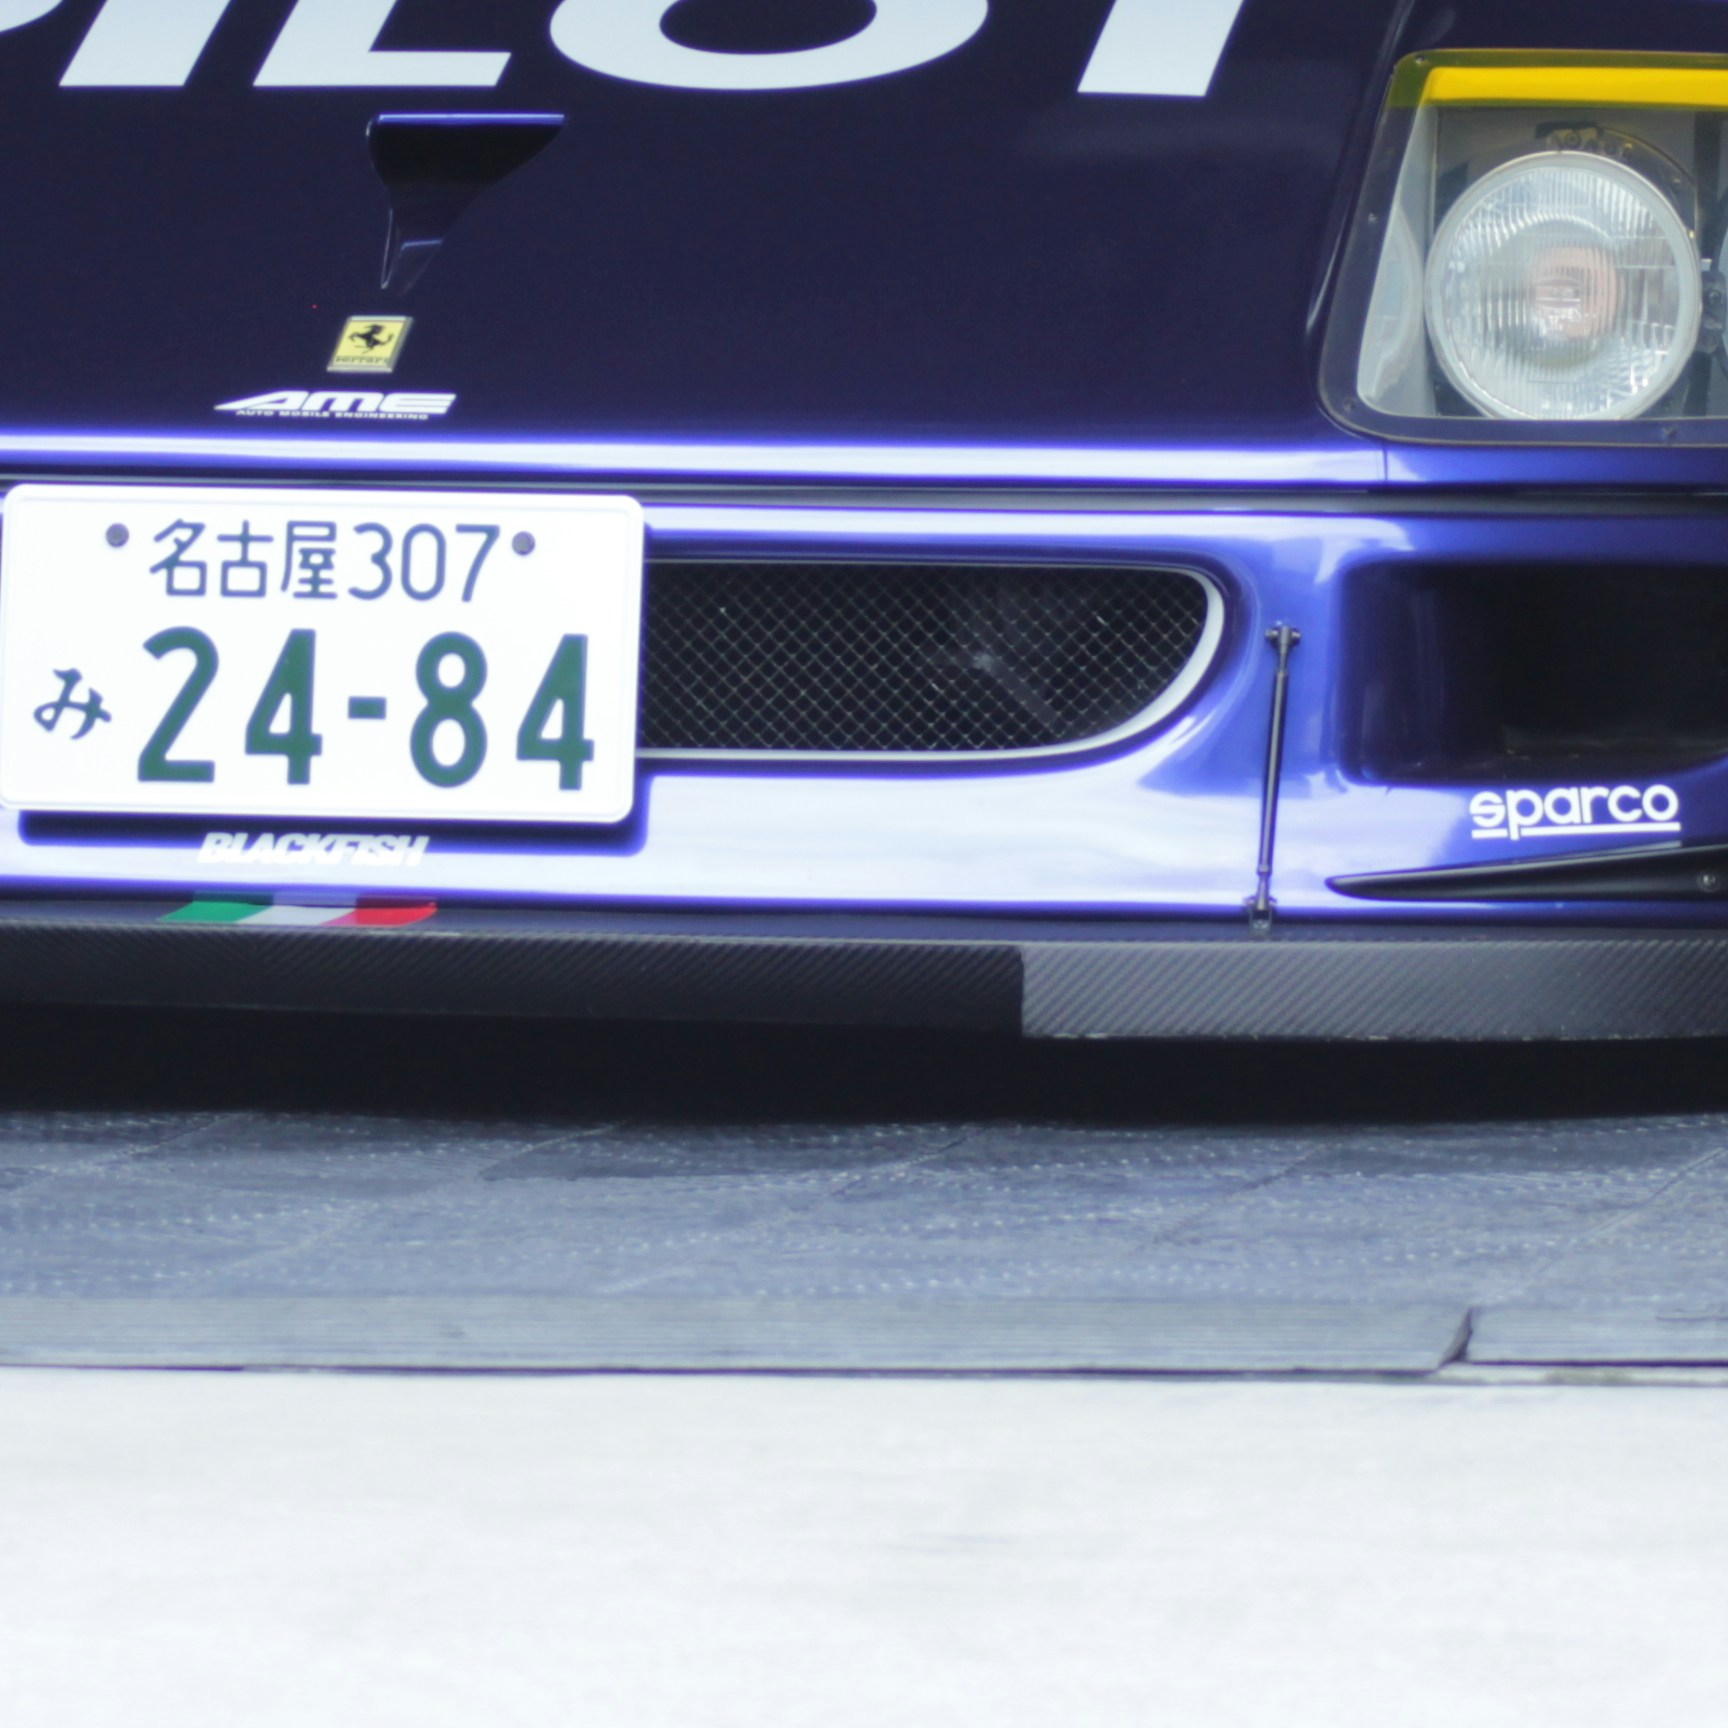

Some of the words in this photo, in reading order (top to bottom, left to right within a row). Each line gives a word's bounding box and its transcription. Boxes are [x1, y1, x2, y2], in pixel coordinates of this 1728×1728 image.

[214, 390, 456, 414] AME
[33, 668, 113, 741] み
[136, 626, 595, 791] 24-84
[1469, 784, 1681, 840] sparco
[197, 832, 430, 865] BLACKFISH
